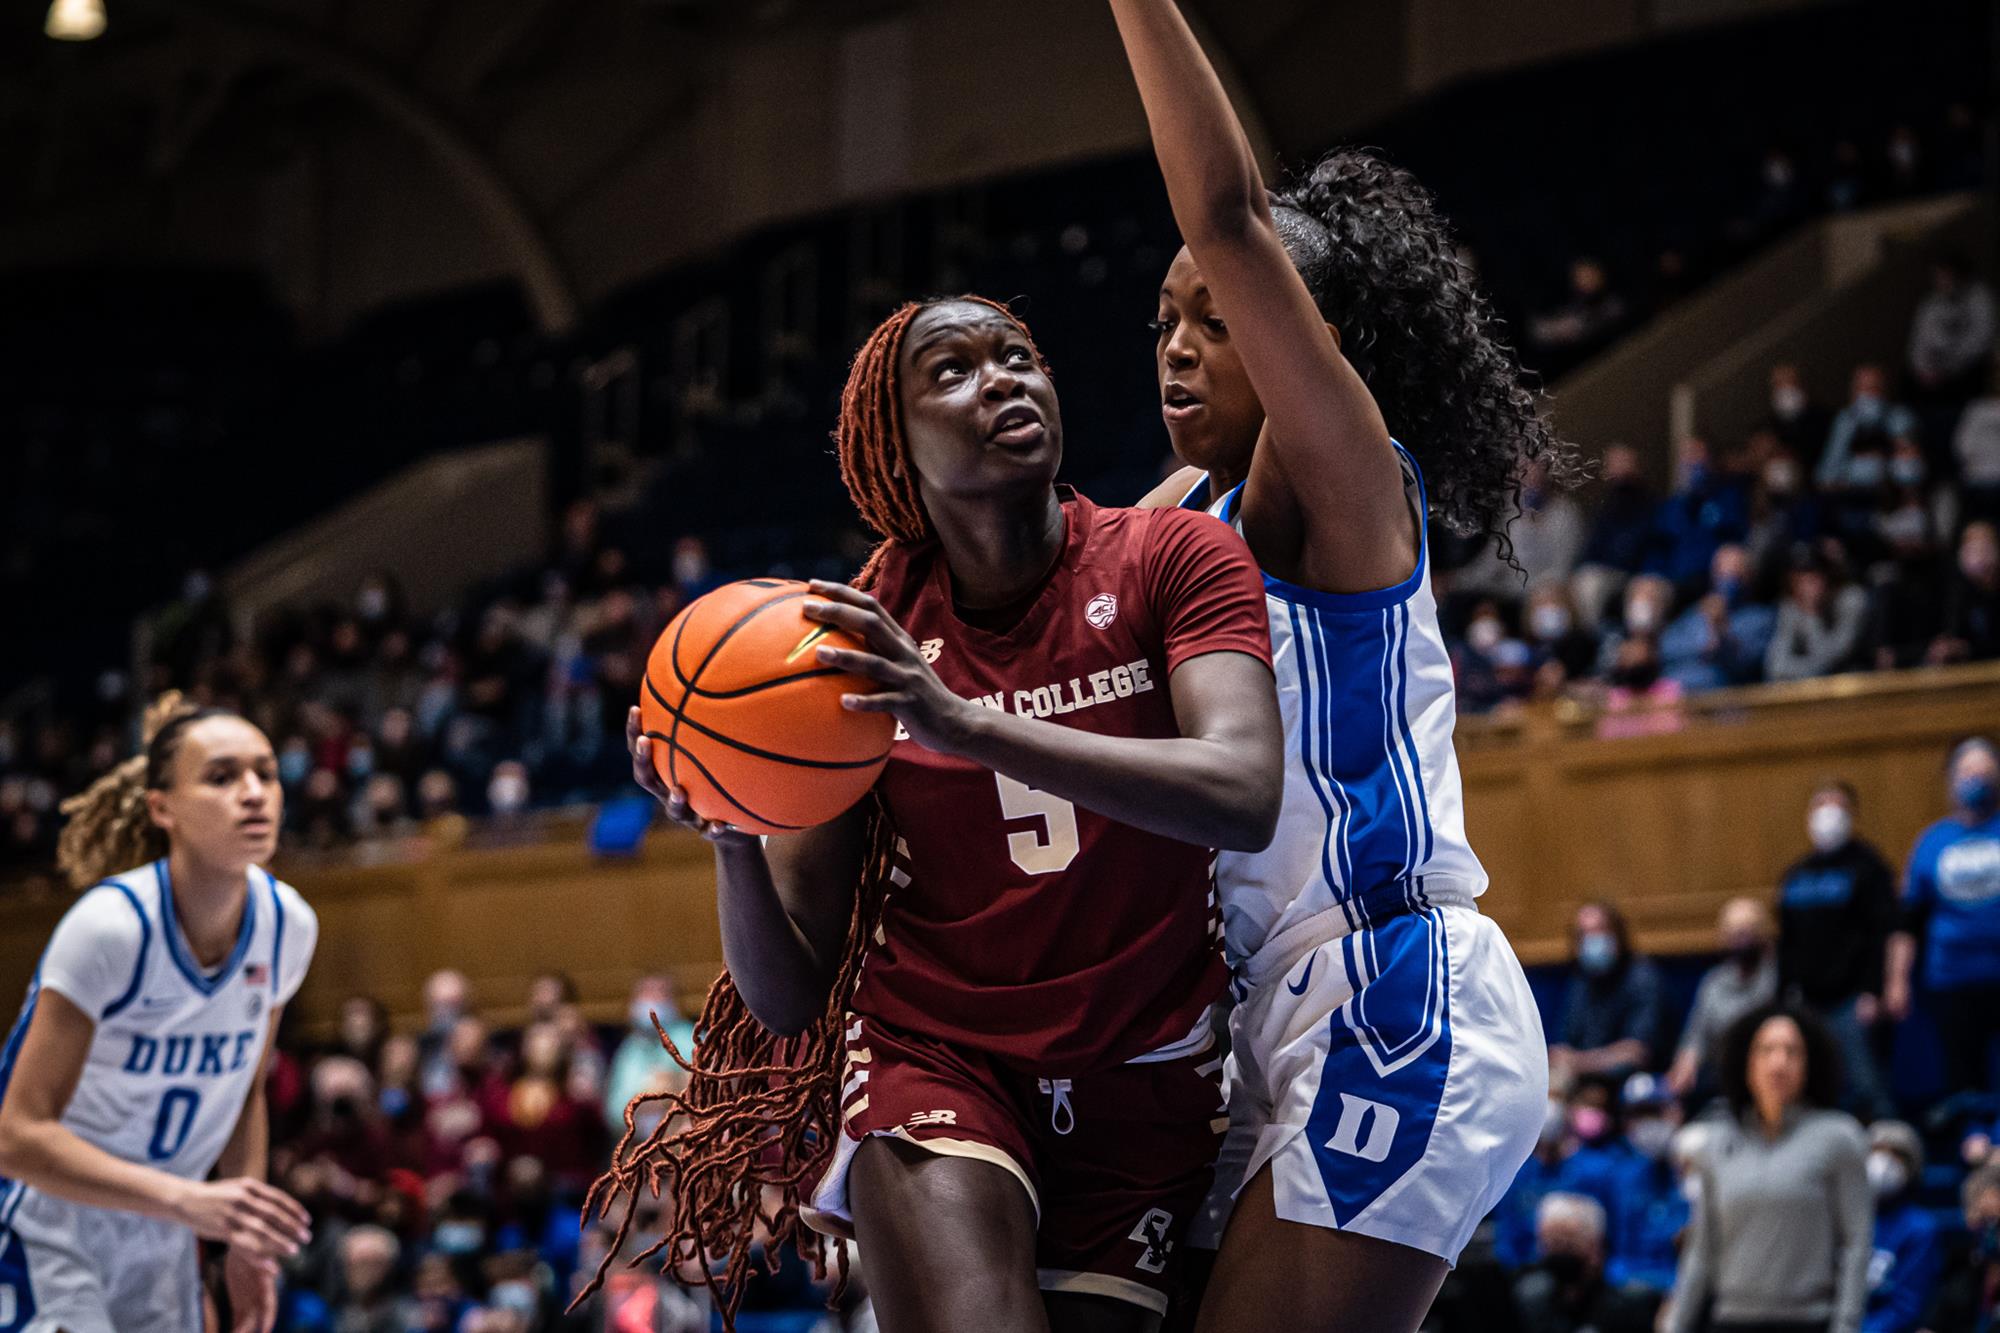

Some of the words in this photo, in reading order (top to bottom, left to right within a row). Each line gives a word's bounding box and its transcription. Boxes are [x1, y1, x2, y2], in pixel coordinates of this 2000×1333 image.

[1013, 658, 1155, 720] COLLEGE
[995, 770, 1080, 875] 5
[123, 1030, 255, 1075] DUKE
[148, 1086, 201, 1161] 0
[1323, 1092, 1400, 1163] D
